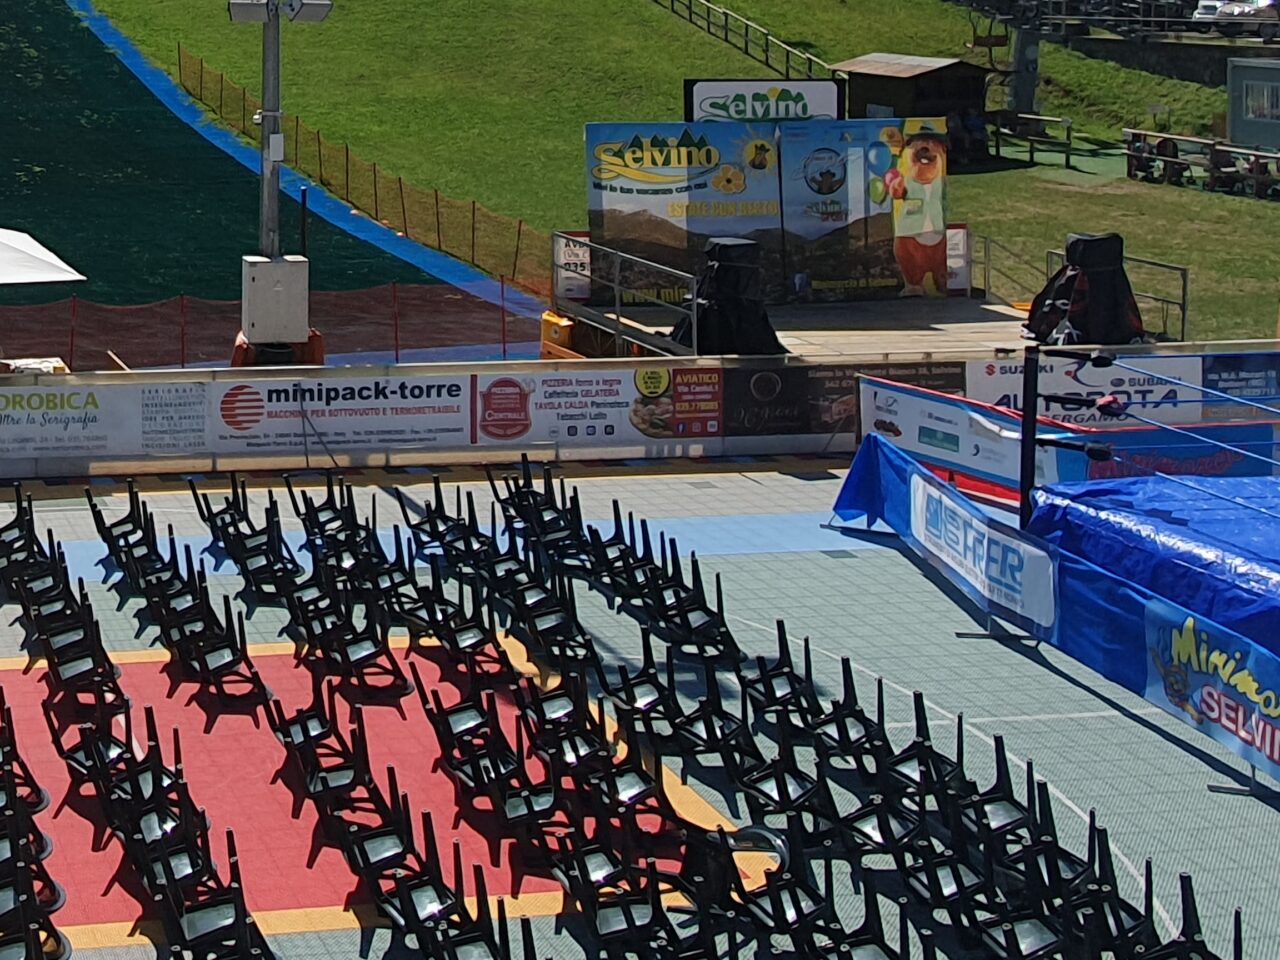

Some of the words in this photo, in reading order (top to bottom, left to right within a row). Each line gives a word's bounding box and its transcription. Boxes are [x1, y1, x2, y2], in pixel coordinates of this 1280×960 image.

[700, 93, 810, 120] Selvino
[592, 137, 720, 180] Selvino
[676, 373, 719, 383] AVIATICO
[999, 364, 1054, 375] SUZKI
[267, 381, 462, 406] minipack-torre
[41, 412, 98, 431] Serigrafia
[311, 409, 327, 418] PER
[328, 407, 380, 417] SOTTOVUOTO
